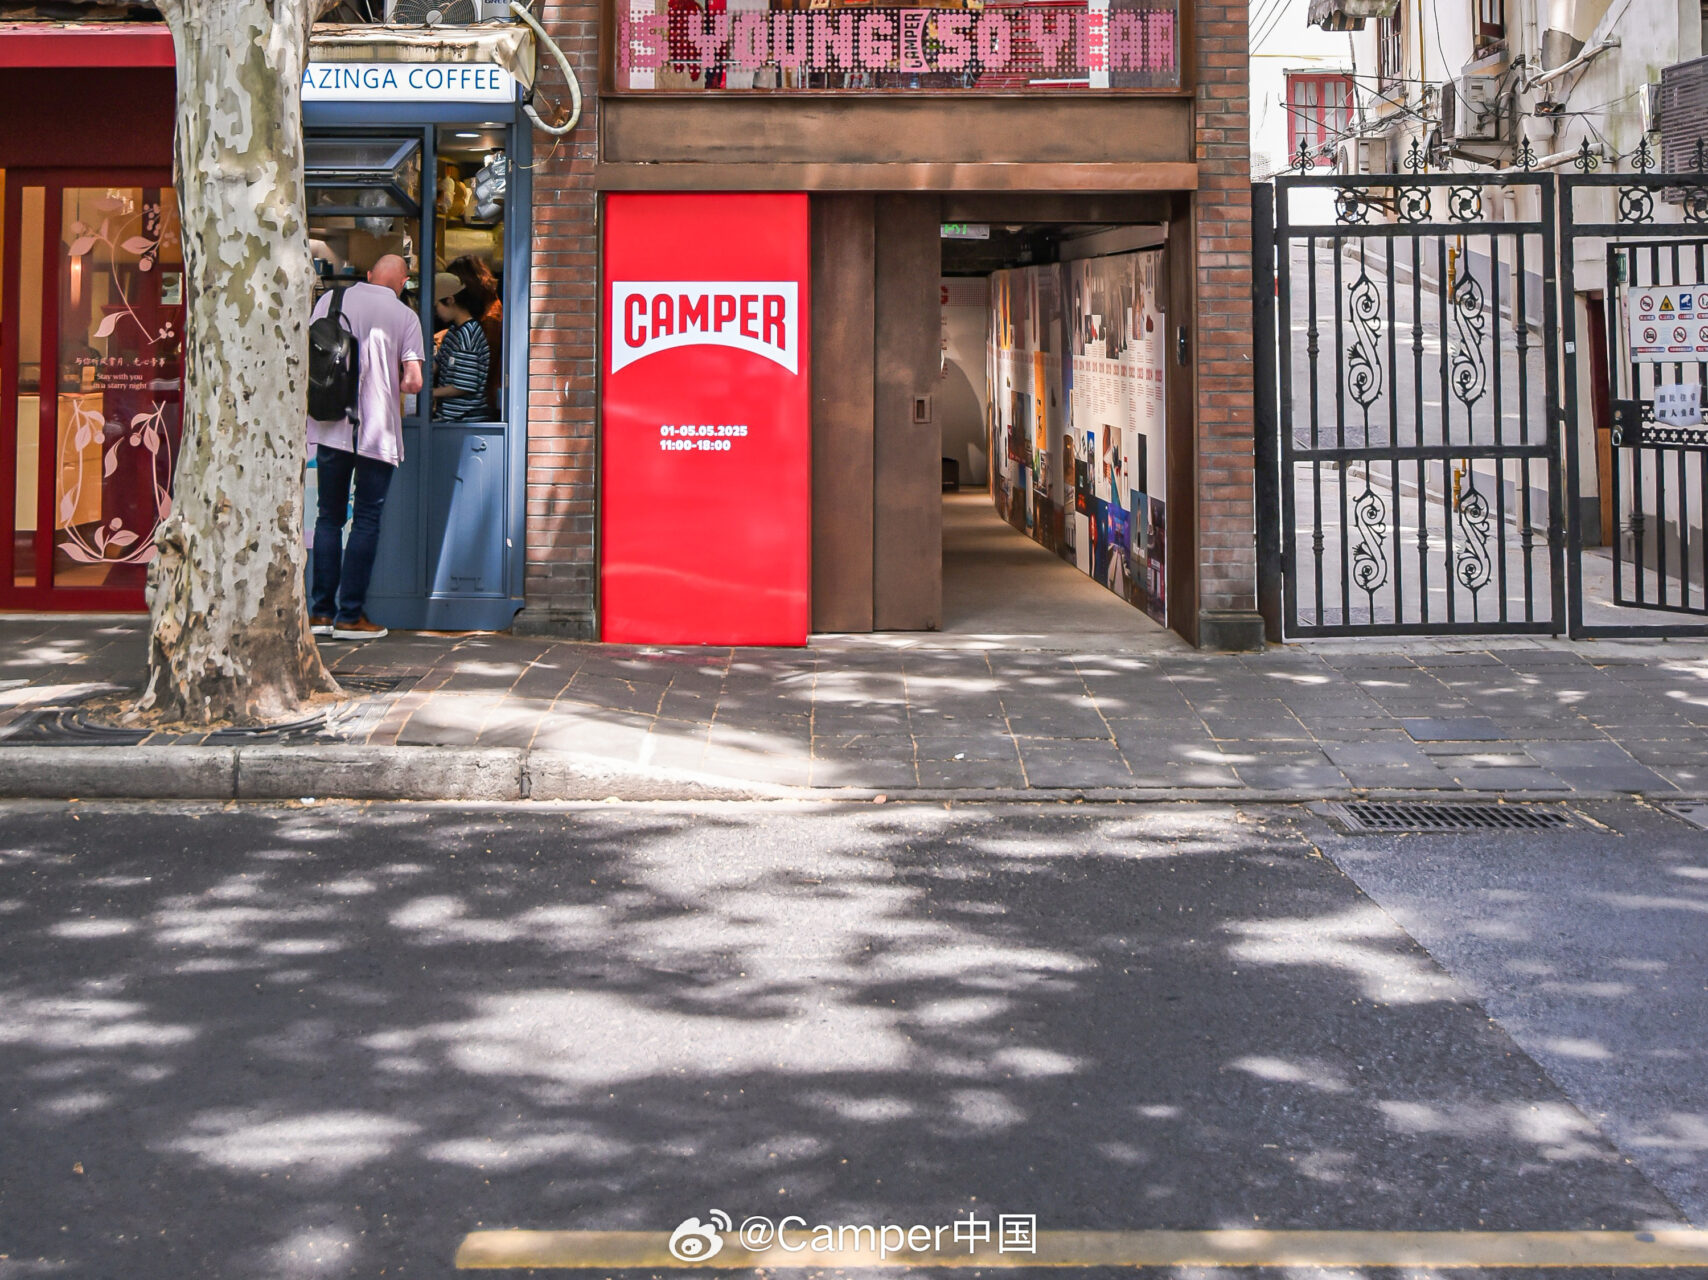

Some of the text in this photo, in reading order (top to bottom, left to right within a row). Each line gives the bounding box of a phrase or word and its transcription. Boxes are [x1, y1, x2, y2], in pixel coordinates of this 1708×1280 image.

[687, 14, 893, 68] YOUNG
[904, 13, 924, 68] CAMPER
[302, 68, 501, 90] AZINGA COFFEE
[624, 293, 786, 351] CAMPER
[97, 373, 111, 382] Stay
[130, 374, 143, 382] you
[108, 383, 127, 391] starry
[129, 382, 147, 390] night
[660, 425, 748, 437] 01-05.05.2025
[660, 439, 731, 451] 11:00-18:00
